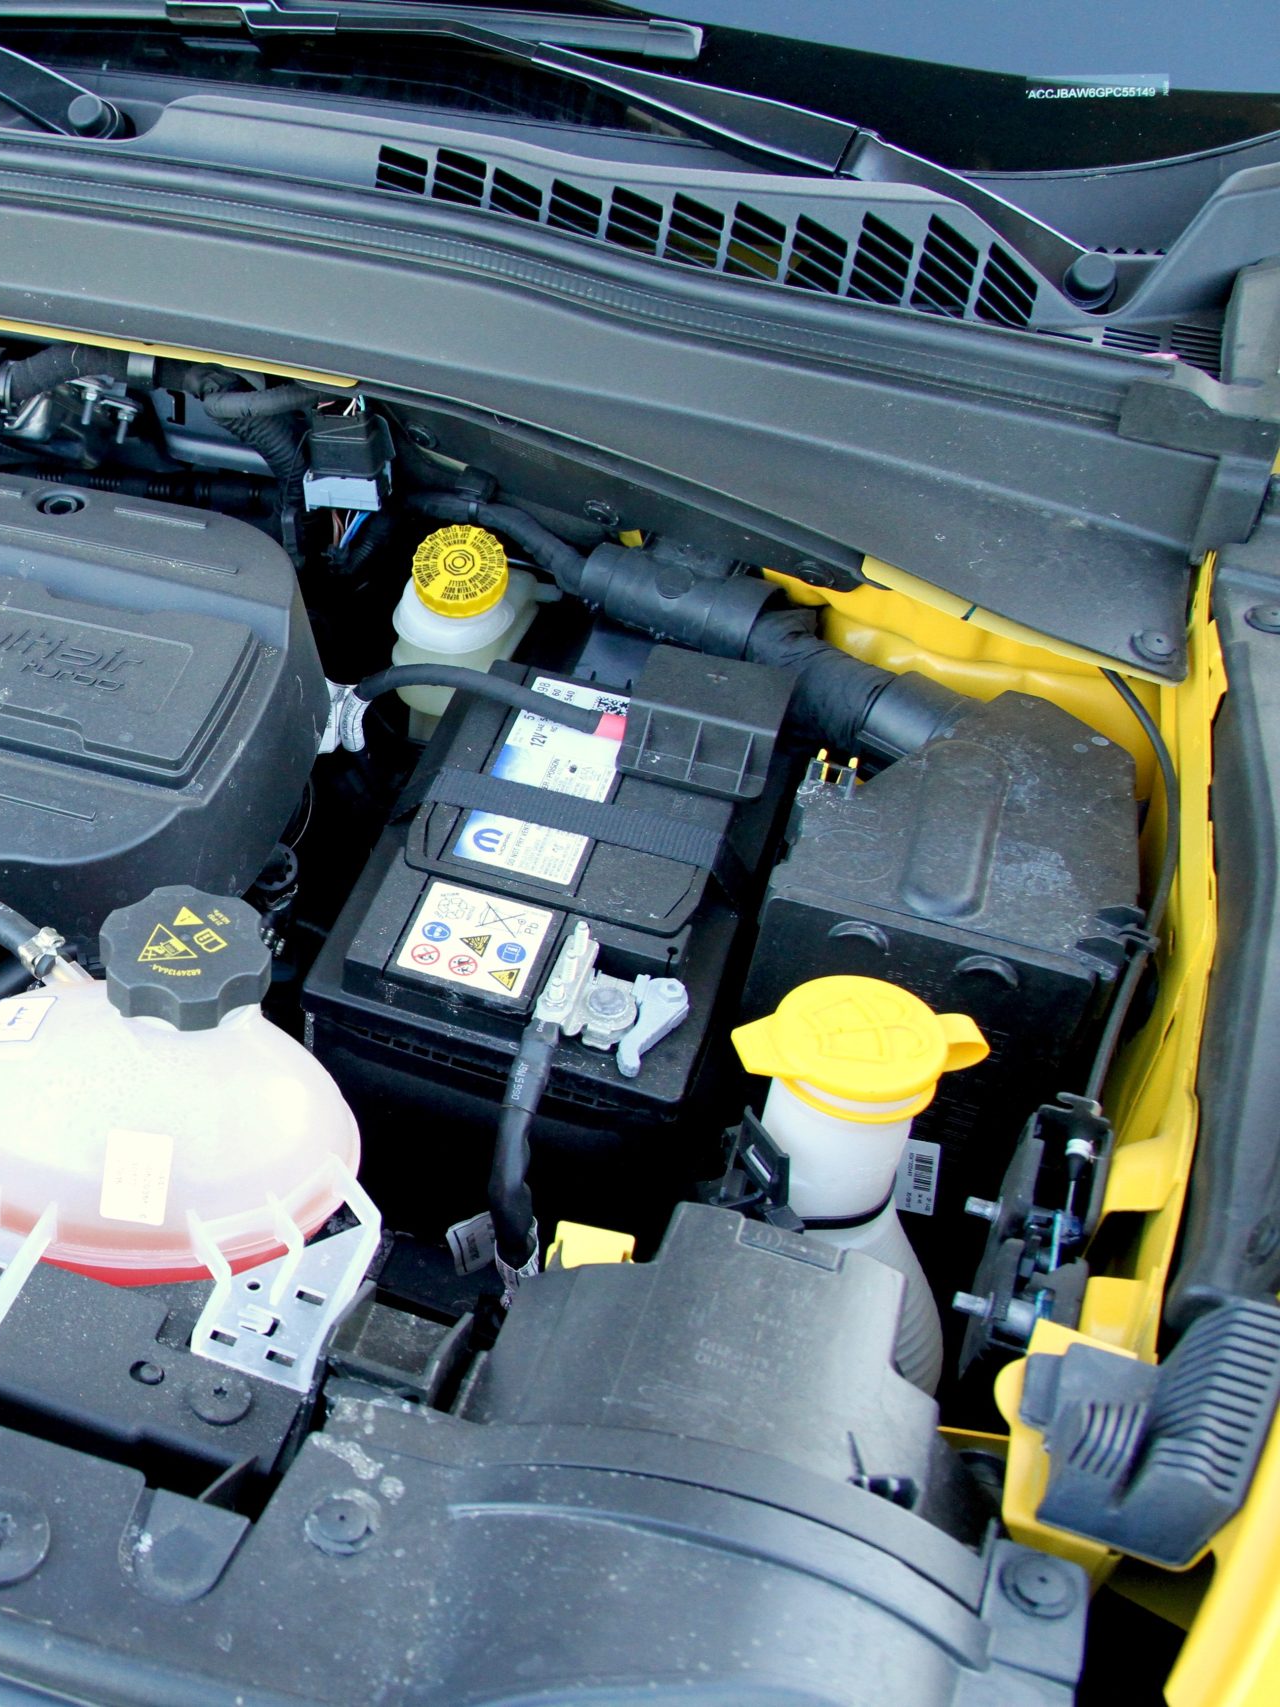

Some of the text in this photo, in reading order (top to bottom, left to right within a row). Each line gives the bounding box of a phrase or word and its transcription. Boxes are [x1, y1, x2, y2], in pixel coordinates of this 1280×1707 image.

[1026, 87, 1156, 99] ACCJBAW6GPC55149
[20, 660, 125, 692] turbo
[530, 732, 548, 747] 12V
[524, 921, 540, 936] Pb
